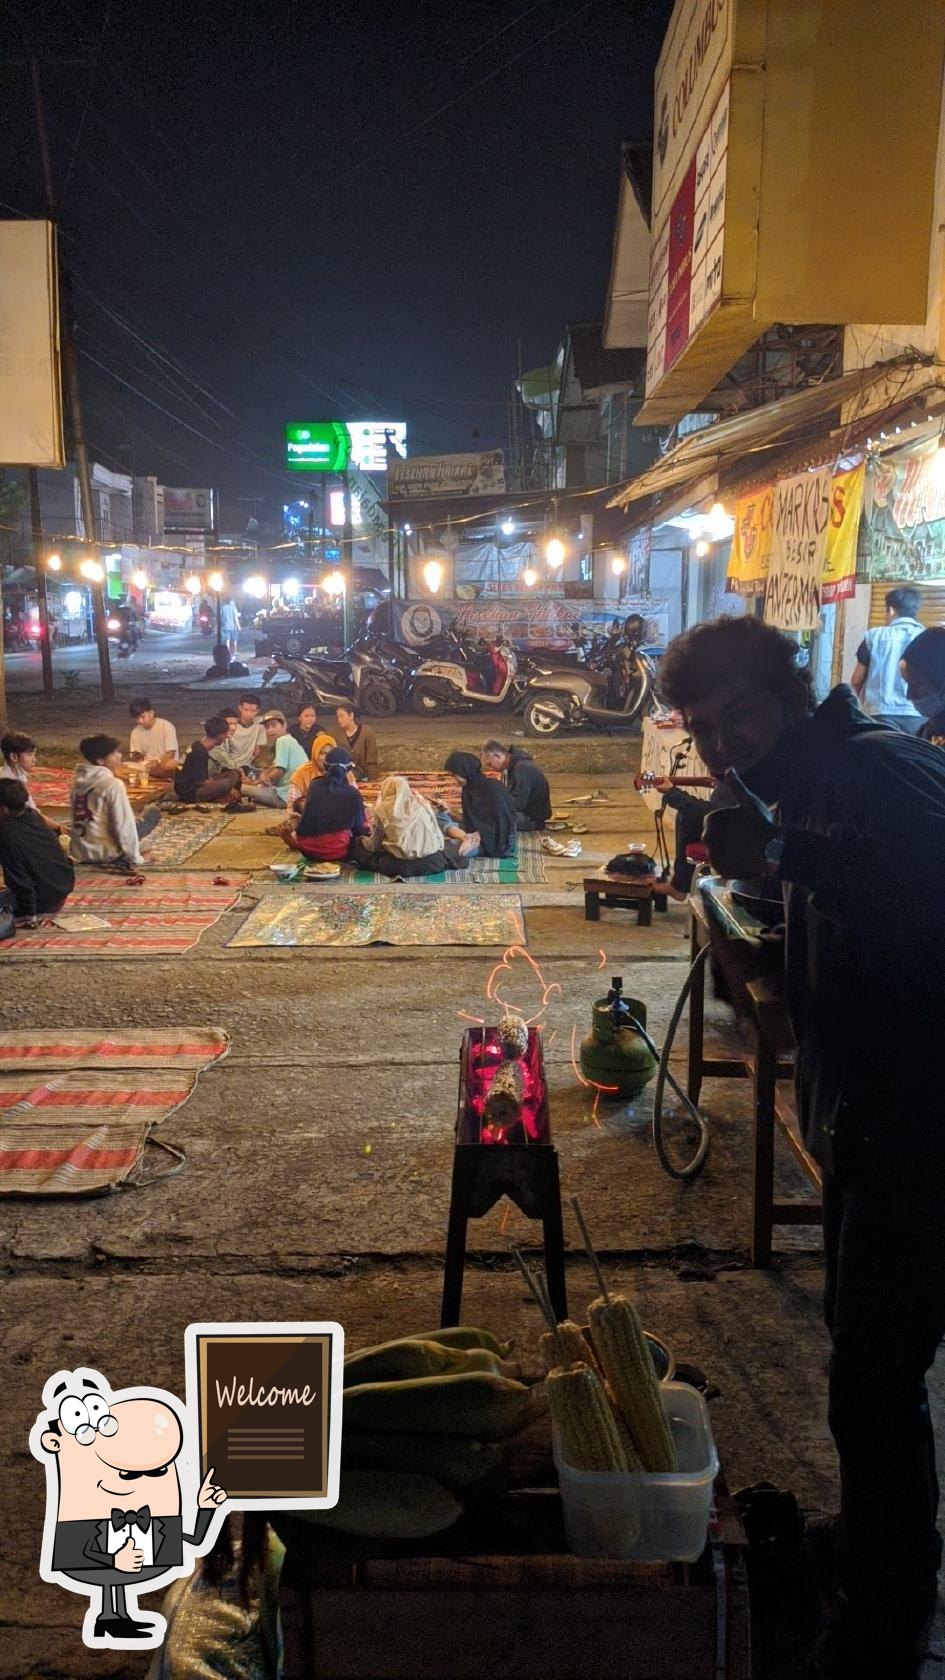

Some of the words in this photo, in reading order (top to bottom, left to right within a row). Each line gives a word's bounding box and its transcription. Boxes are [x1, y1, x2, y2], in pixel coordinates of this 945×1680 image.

[671, 0, 723, 137] COLUMBU
[288, 443, 330, 454] Pegadai
[776, 478, 829, 537] MARKAS
